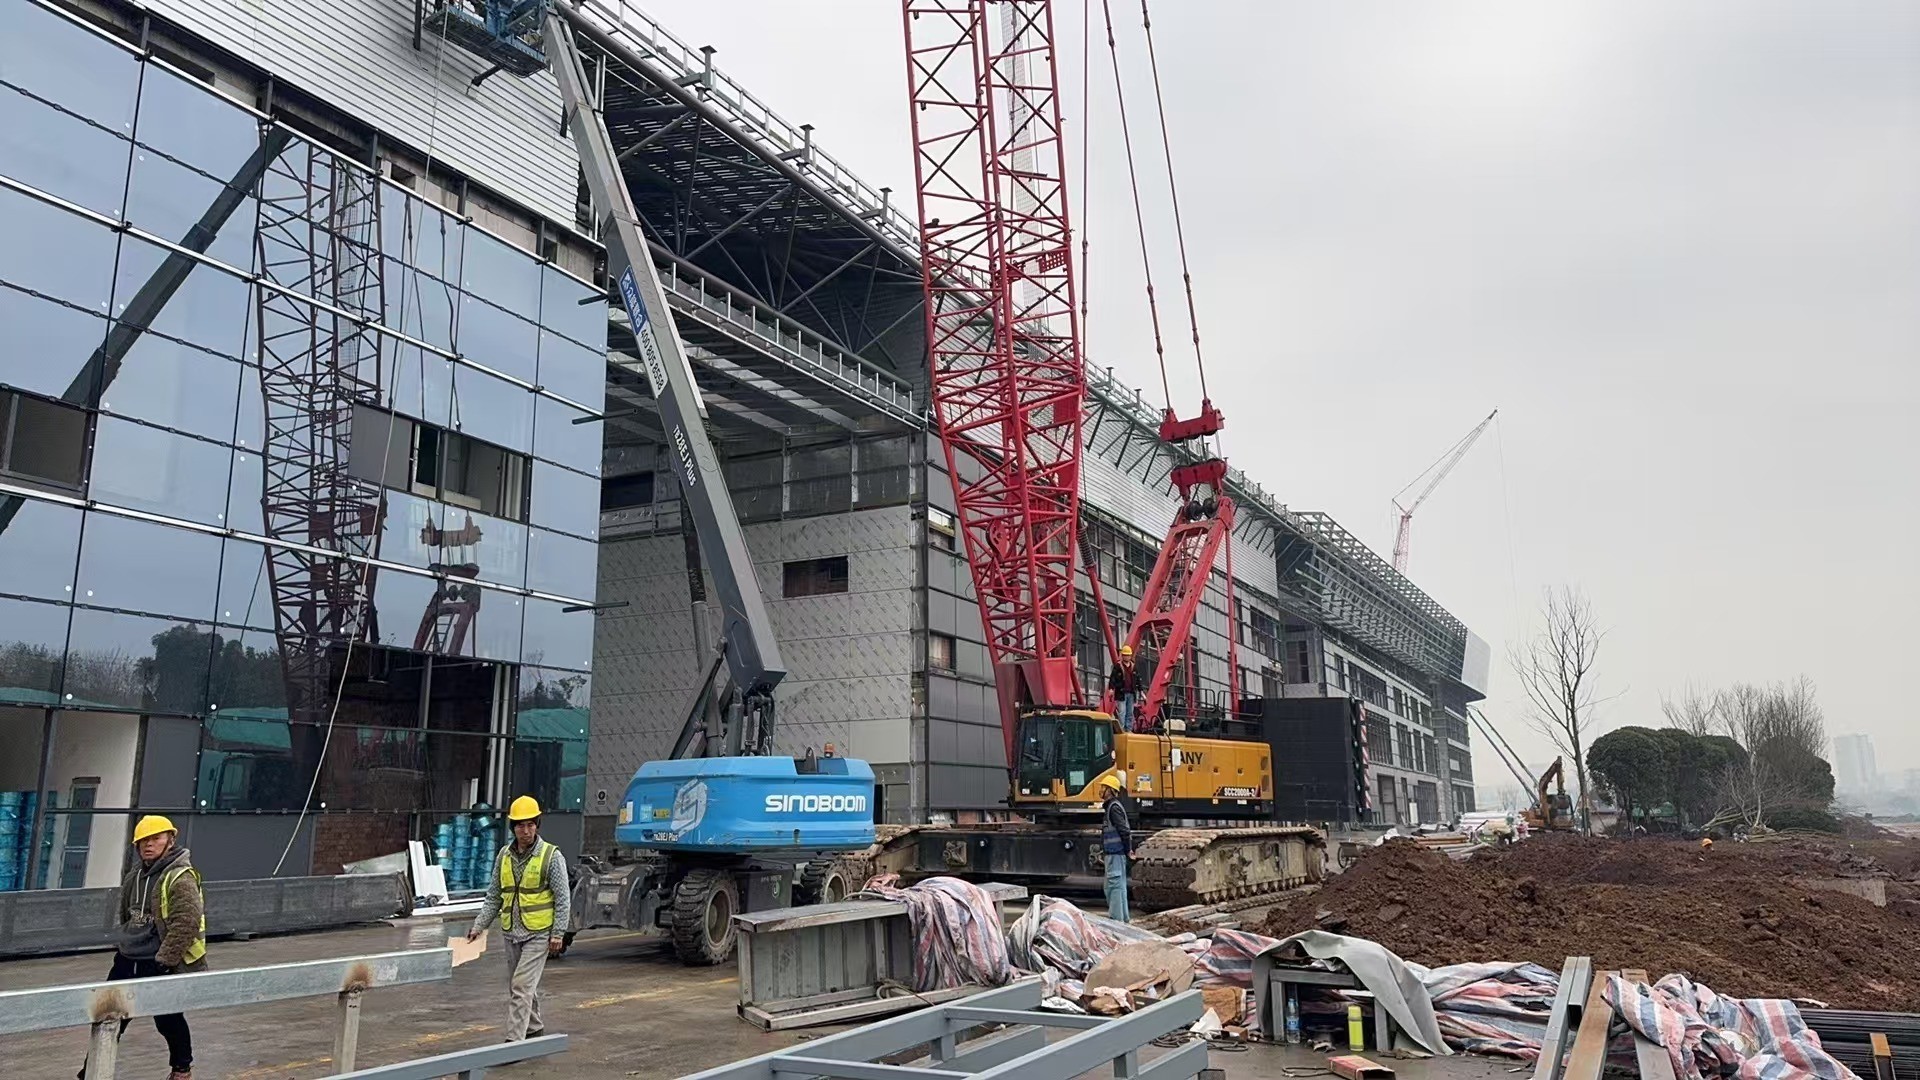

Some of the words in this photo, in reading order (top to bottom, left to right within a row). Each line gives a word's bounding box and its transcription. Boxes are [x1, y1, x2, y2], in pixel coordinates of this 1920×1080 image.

[640, 329, 651, 349] 400
[673, 424, 690, 462] TB28EJ
[684, 457, 697, 487] Plus
[765, 794, 866, 812] SINOBOOM
